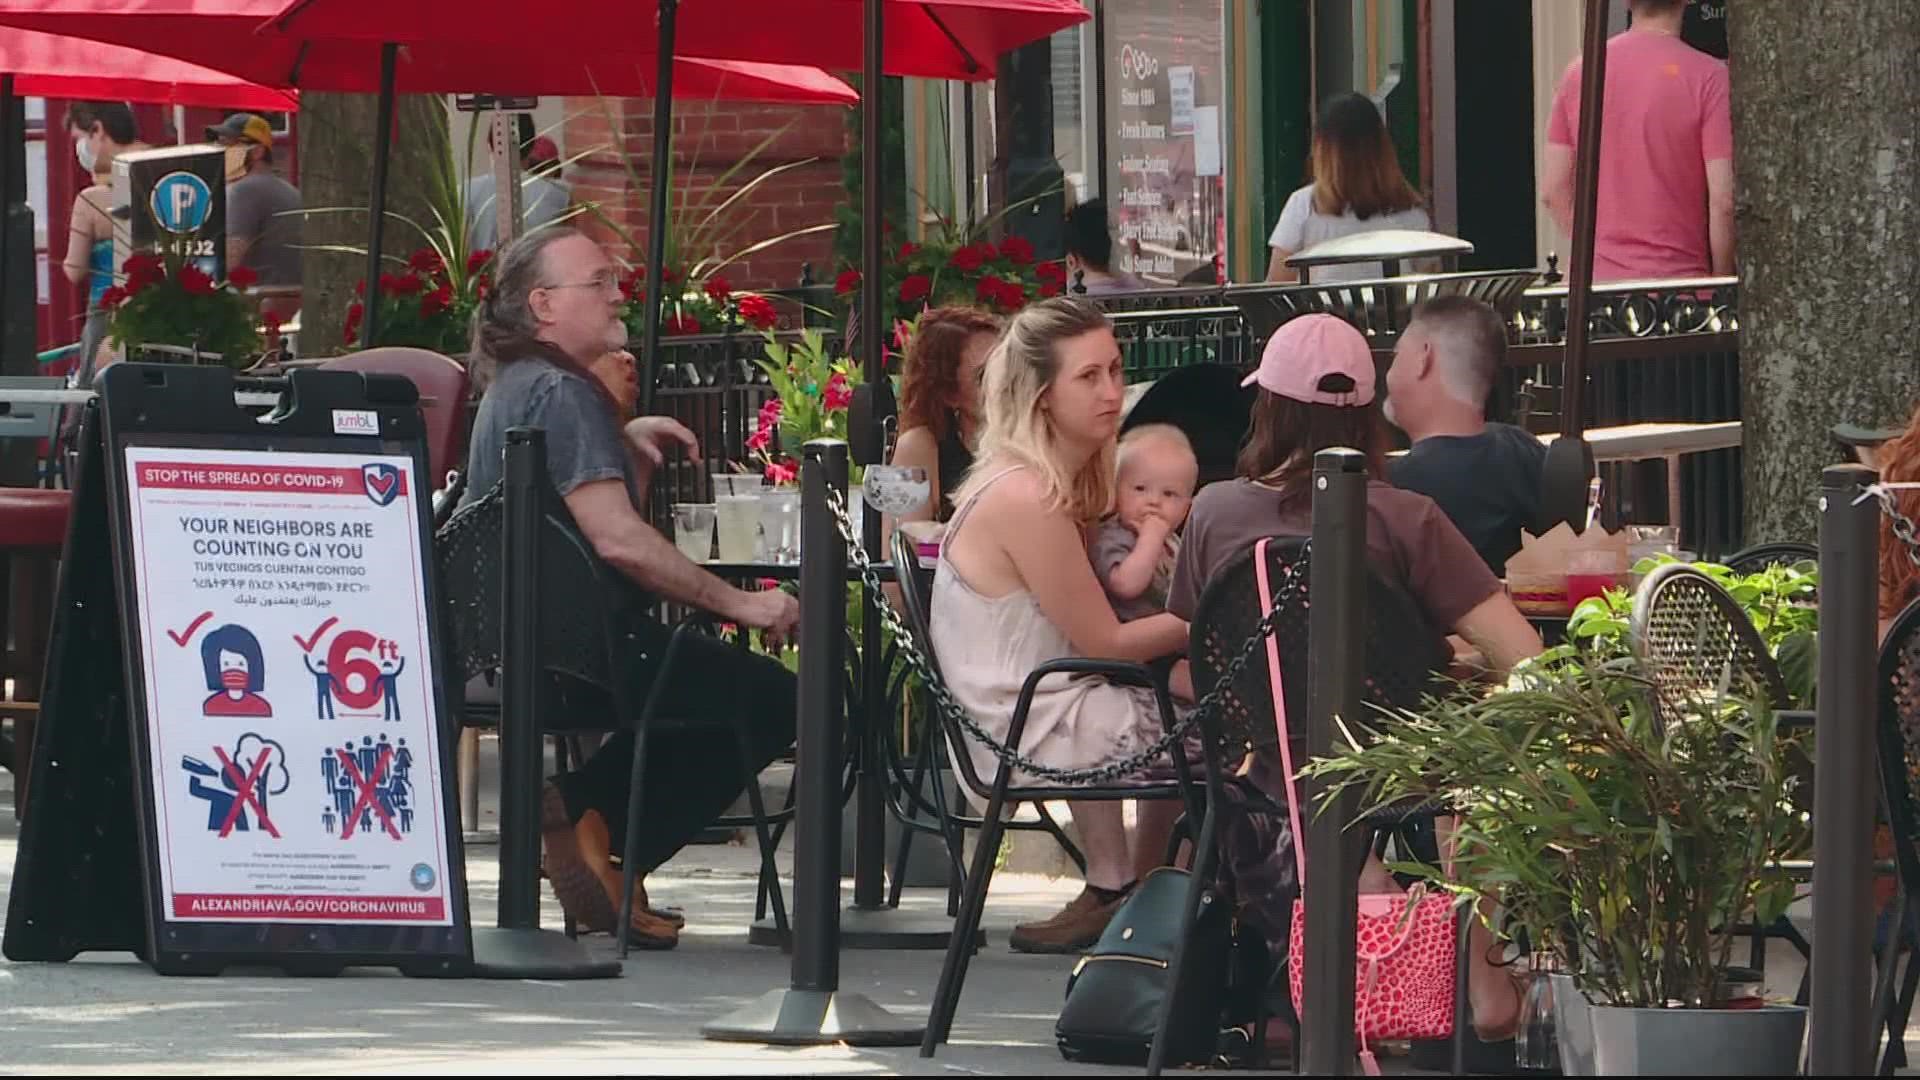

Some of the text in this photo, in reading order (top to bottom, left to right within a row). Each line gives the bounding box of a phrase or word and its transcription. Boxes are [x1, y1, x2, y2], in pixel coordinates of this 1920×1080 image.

[171, 183, 197, 225] P
[144, 469, 343, 488] STOP THE SPREAD OF COVID-19
[179, 517, 374, 538] YOUR NEIGHBORS ARE
[193, 539, 363, 559] COUNTING ON YOU
[194, 561, 366, 576] TUS VECINOS CUENTAN CONTIGO
[192, 899, 426, 914] ALEXANDRIAVA.GOV/CORONAVIRUS
